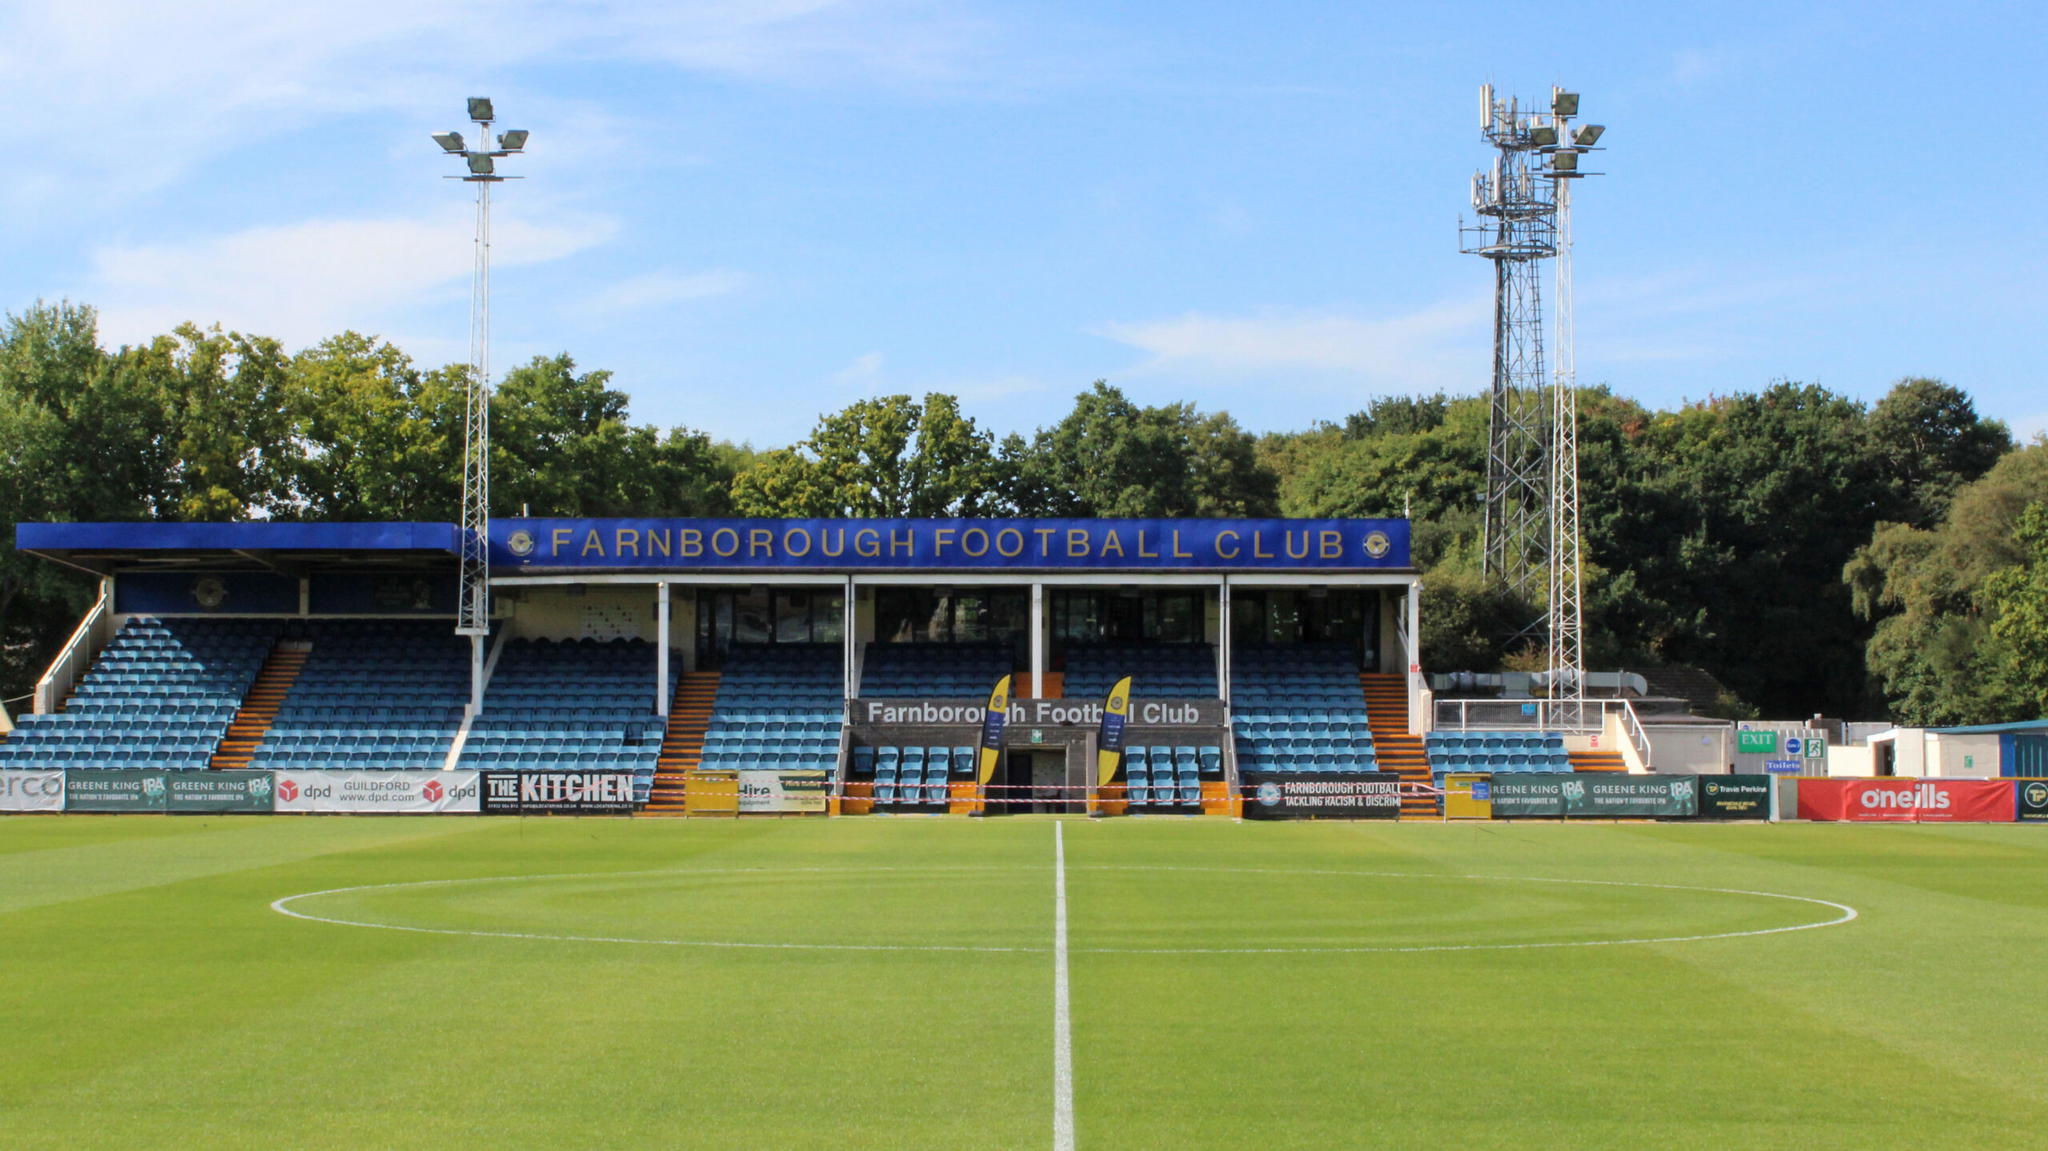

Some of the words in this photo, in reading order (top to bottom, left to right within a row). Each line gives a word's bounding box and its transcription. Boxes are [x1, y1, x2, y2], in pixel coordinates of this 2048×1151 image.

[551, 527, 915, 558] FARNBOROUGH
[934, 528, 1193, 558] FOOTBALL
[1214, 529, 1344, 559] CLUB
[868, 702, 1026, 727] Farnboroh
[1036, 702, 1135, 724] Footbl
[1143, 703, 1200, 724] Club
[1742, 733, 1774, 745] EXIT
[1767, 761, 1800, 770] Toilets
[0, 776, 63, 797] rco
[68, 781, 110, 791] GREENE
[112, 781, 140, 791] KING
[142, 777, 166, 793] IPA
[172, 781, 215, 791] GREENE
[218, 781, 246, 791] KING
[248, 777, 271, 793] IPA
[303, 784, 332, 800] dpd
[343, 781, 411, 791] GUILDFORD
[448, 784, 477, 800] dpd
[487, 779, 518, 797] THE
[521, 774, 634, 802] KITCHEN
[1284, 781, 1354, 794] FARNBOROUGH
[1356, 781, 1402, 794] FOOTBALL
[1492, 784, 1528, 794] REENE
[1530, 784, 1559, 794] KING
[1561, 780, 1585, 797] IPA
[1592, 784, 1636, 794] GREENE
[1639, 784, 1668, 794] KING
[1669, 780, 1694, 797] IPA
[339, 792, 415, 804] www.dpd.com
[1284, 795, 1323, 807] TACKLING
[1325, 795, 1356, 807] RACISM
[1357, 796, 1364, 807] &
[2028, 788, 2047, 802] TP
